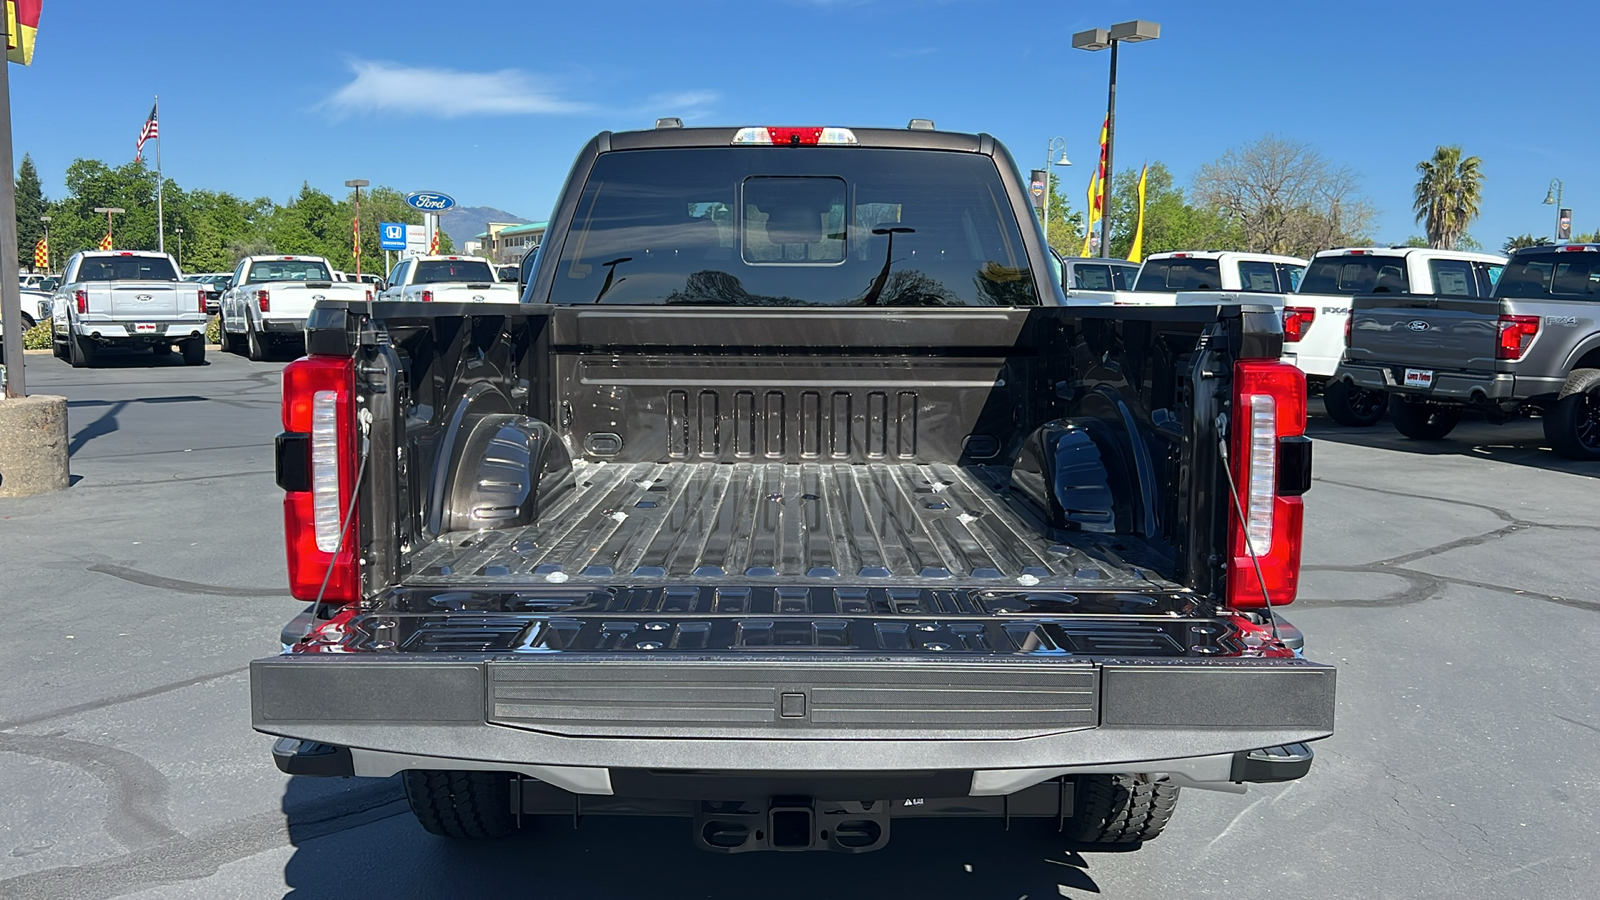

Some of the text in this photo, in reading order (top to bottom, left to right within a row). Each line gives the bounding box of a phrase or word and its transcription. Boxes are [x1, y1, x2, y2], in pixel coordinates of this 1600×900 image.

[415, 194, 446, 209] Ford
[1322, 306, 1348, 316] FX4
[1546, 315, 1577, 325] FX4
